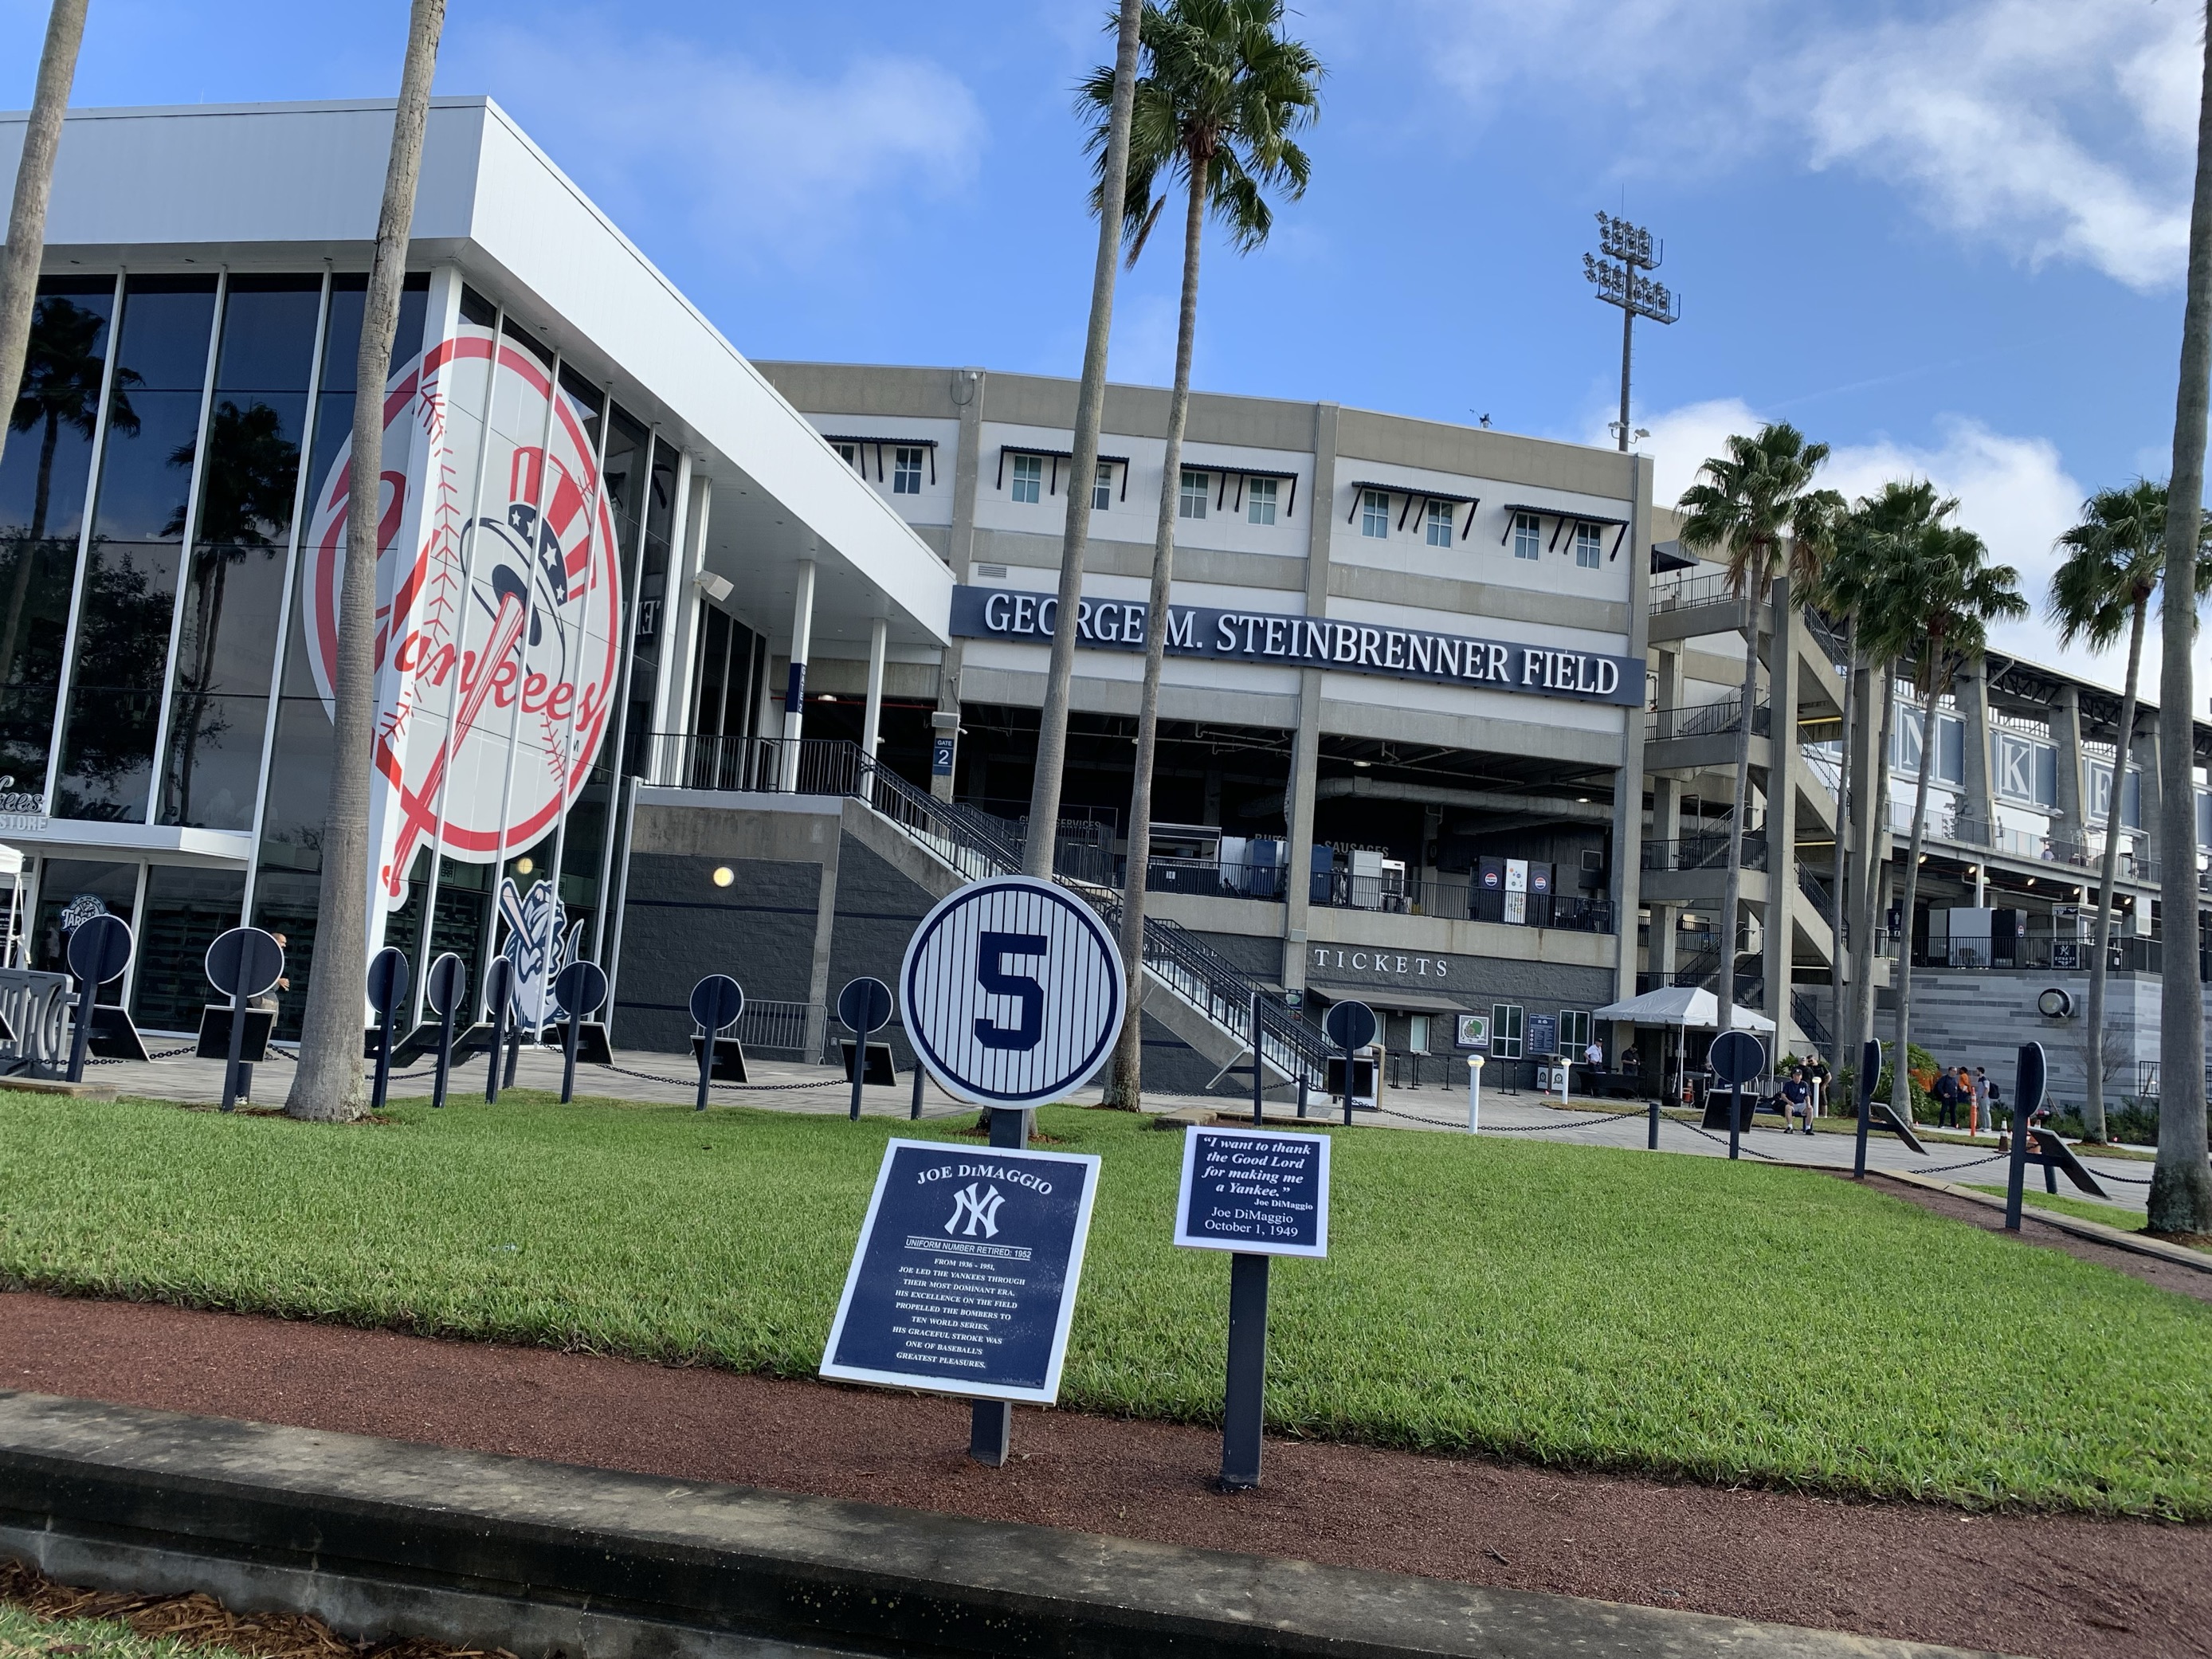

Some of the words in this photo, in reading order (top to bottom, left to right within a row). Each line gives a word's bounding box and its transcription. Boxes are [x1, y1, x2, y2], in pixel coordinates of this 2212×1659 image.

[1164, 609, 1202, 649] M.
[1216, 614, 1511, 683] STEINBRENNER
[1521, 649, 1619, 695] FIELD
[798, 703, 803, 712] 2
[938, 749, 949, 765] 2
[0, 815, 47, 832] STORE
[1315, 949, 1448, 977] TICKETS
[975, 931, 1048, 1051] 5
[1221, 1140, 1253, 1151] want
[1255, 1141, 1269, 1151] to
[1272, 1143, 1312, 1155] thank
[1206, 1151, 1228, 1163] the
[1232, 1153, 1269, 1166] Good
[1271, 1156, 1305, 1169] Lord
[917, 1166, 952, 1184] JOE
[1201, 1166, 1226, 1178] for
[1228, 1169, 1280, 1184] making
[1282, 1175, 1304, 1183] me
[1215, 1183, 1225, 1192] a
[1271, 1199, 1313, 1211] DiMaggio
[1211, 1207, 1231, 1218] Joe
[1235, 1209, 1293, 1224] DiMaggio
[1205, 1219, 1252, 1233] October
[1256, 1225, 1265, 1235] 1,
[1270, 1226, 1299, 1237] 1949
[905, 1238, 941, 1249] UNIFORM
[942, 1243, 975, 1253] NUMBER
[976, 1246, 1012, 1257] RETIRED:
[1014, 1249, 1031, 1259] 1952
[934, 1258, 956, 1267] FROM
[903, 1278, 928, 1287] THEIR
[928, 1281, 951, 1290] MOST
[953, 1284, 995, 1295] DOMINANT
[951, 1272, 986, 1281] YANKEES
[987, 1276, 1026, 1286] THROUGH
[911, 1291, 961, 1303] EXCELLENCE
[994, 1300, 1018, 1309] FIELD
[895, 1302, 940, 1312] PROPELLED
[960, 1309, 998, 1319] BOMBERS
[929, 1318, 959, 1327] WORLD
[960, 1321, 989, 1331] SERIES.
[908, 1328, 950, 1339] GRACEFUL
[951, 1333, 983, 1343] STROKE
[896, 1351, 937, 1363] GREATEST
[939, 1357, 986, 1368] PLEASURES.
